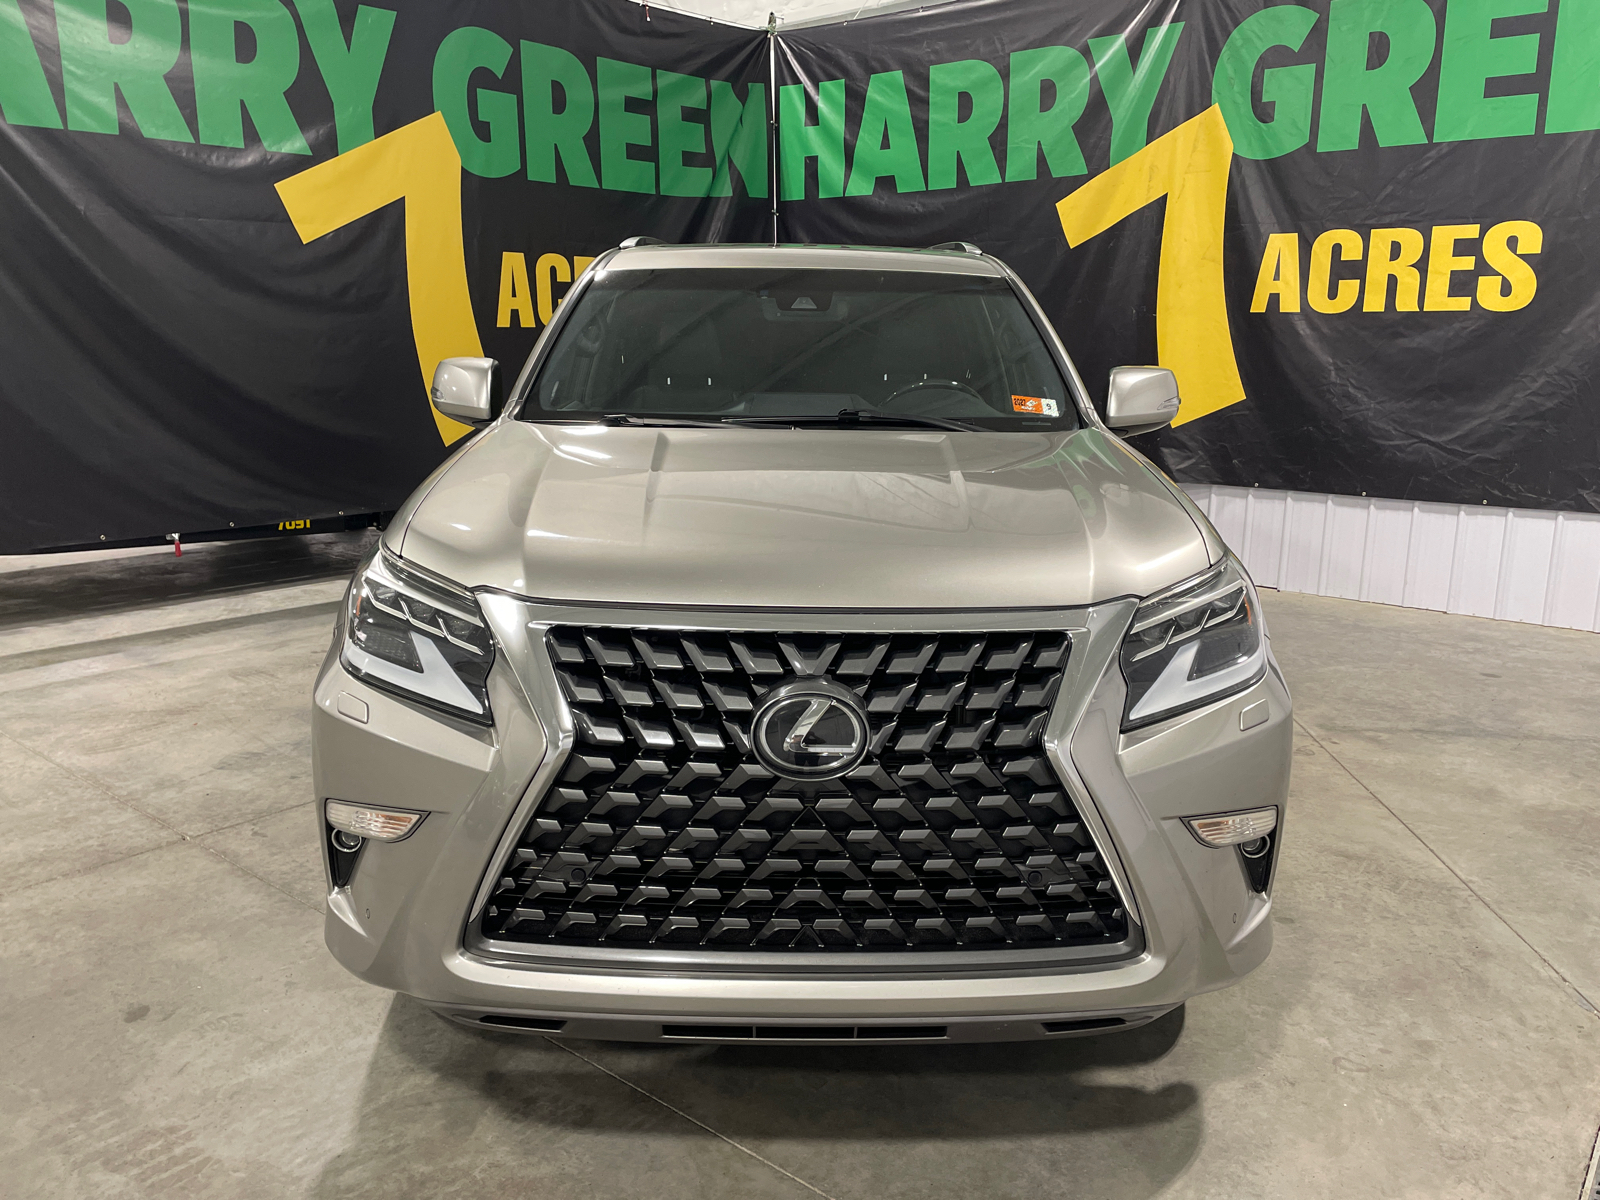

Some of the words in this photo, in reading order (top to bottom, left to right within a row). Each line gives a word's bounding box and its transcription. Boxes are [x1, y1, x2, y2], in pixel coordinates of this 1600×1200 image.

[433, 27, 769, 199] GREEN
[779, 21, 1186, 201] HARRY
[274, 110, 486, 447] 7
[496, 251, 596, 327] AC
[1056, 102, 1247, 428] 7
[1250, 220, 1544, 313] ACRES
